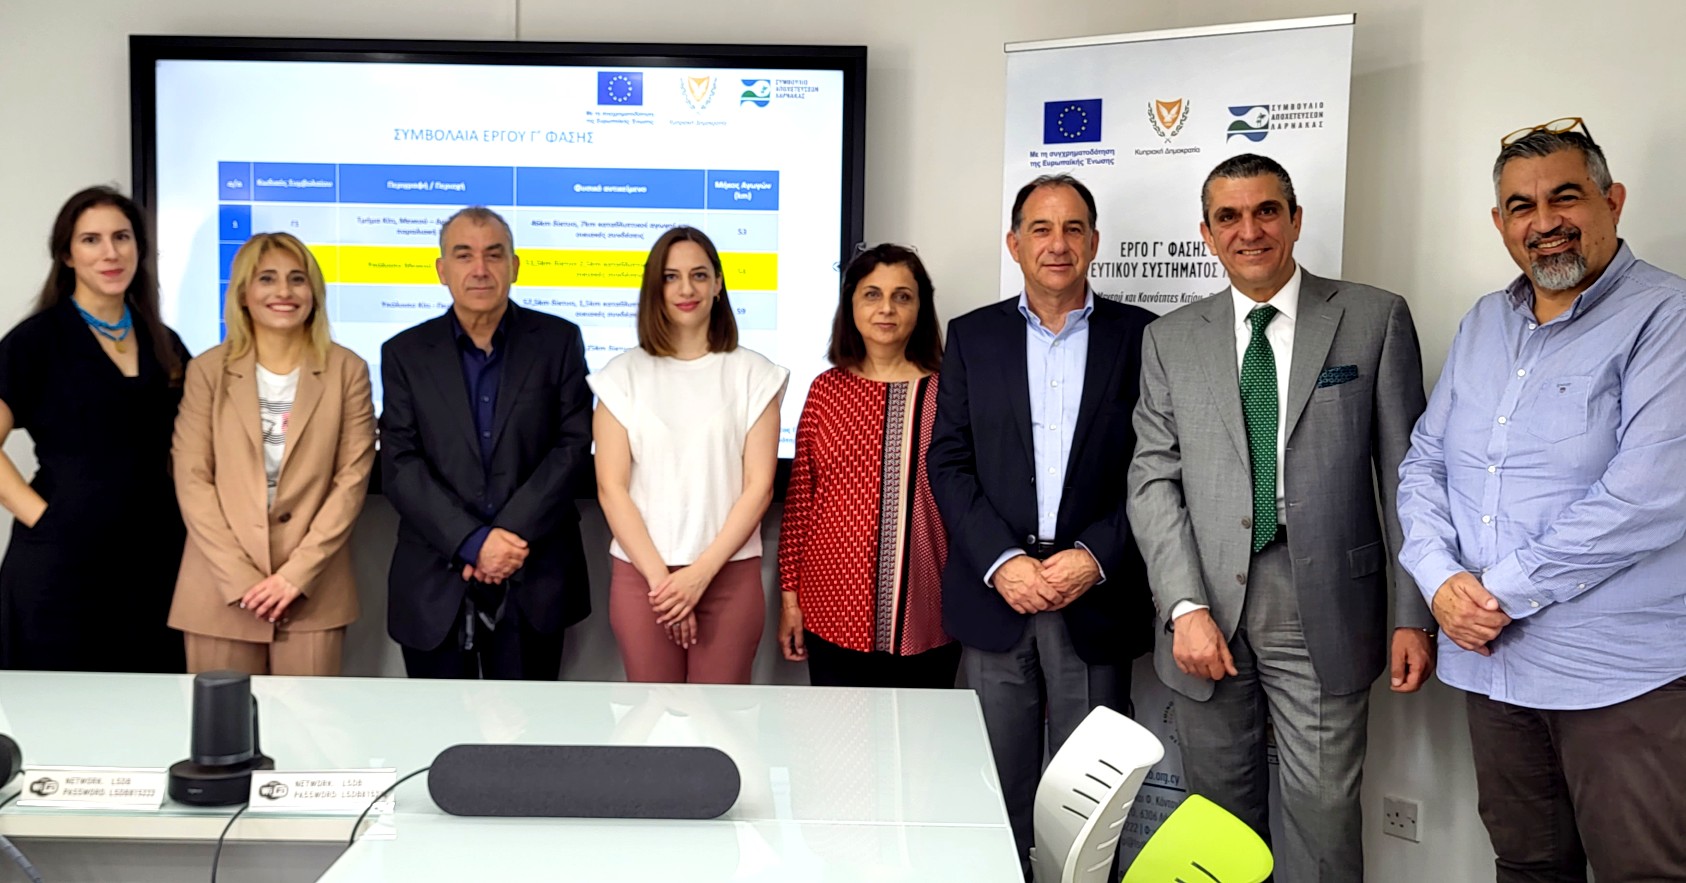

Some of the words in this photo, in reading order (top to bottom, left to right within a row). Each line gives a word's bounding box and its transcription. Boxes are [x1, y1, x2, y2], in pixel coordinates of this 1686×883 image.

[1271, 102, 1324, 111] ΣΥΜΒΟΥΛΙΟ
[1271, 112, 1324, 120] ΑΠΟΧΕΤΕΥΣΕΩΝ
[1271, 120, 1323, 130] ΛΑΡΝΑΚΑΣ
[393, 128, 479, 142] ΣΥΜΒΟΛΑΙΑ
[483, 130, 526, 143] ΕΡΓΟΥ
[545, 130, 594, 144] ΦΑΣΗΣ
[1040, 151, 1048, 159] τη
[1134, 148, 1163, 156] Κυπριακή
[1164, 146, 1201, 156] Δημοκρατία
[1120, 242, 1148, 258] ΕΡΓΟ
[1168, 241, 1208, 258] ΦΑΣΗΣ
[1090, 262, 1138, 278] ΕΥΤΙΚΟΥ
[1142, 262, 1218, 278] ΣΥΣΤΗΜΑΤΟΣ
